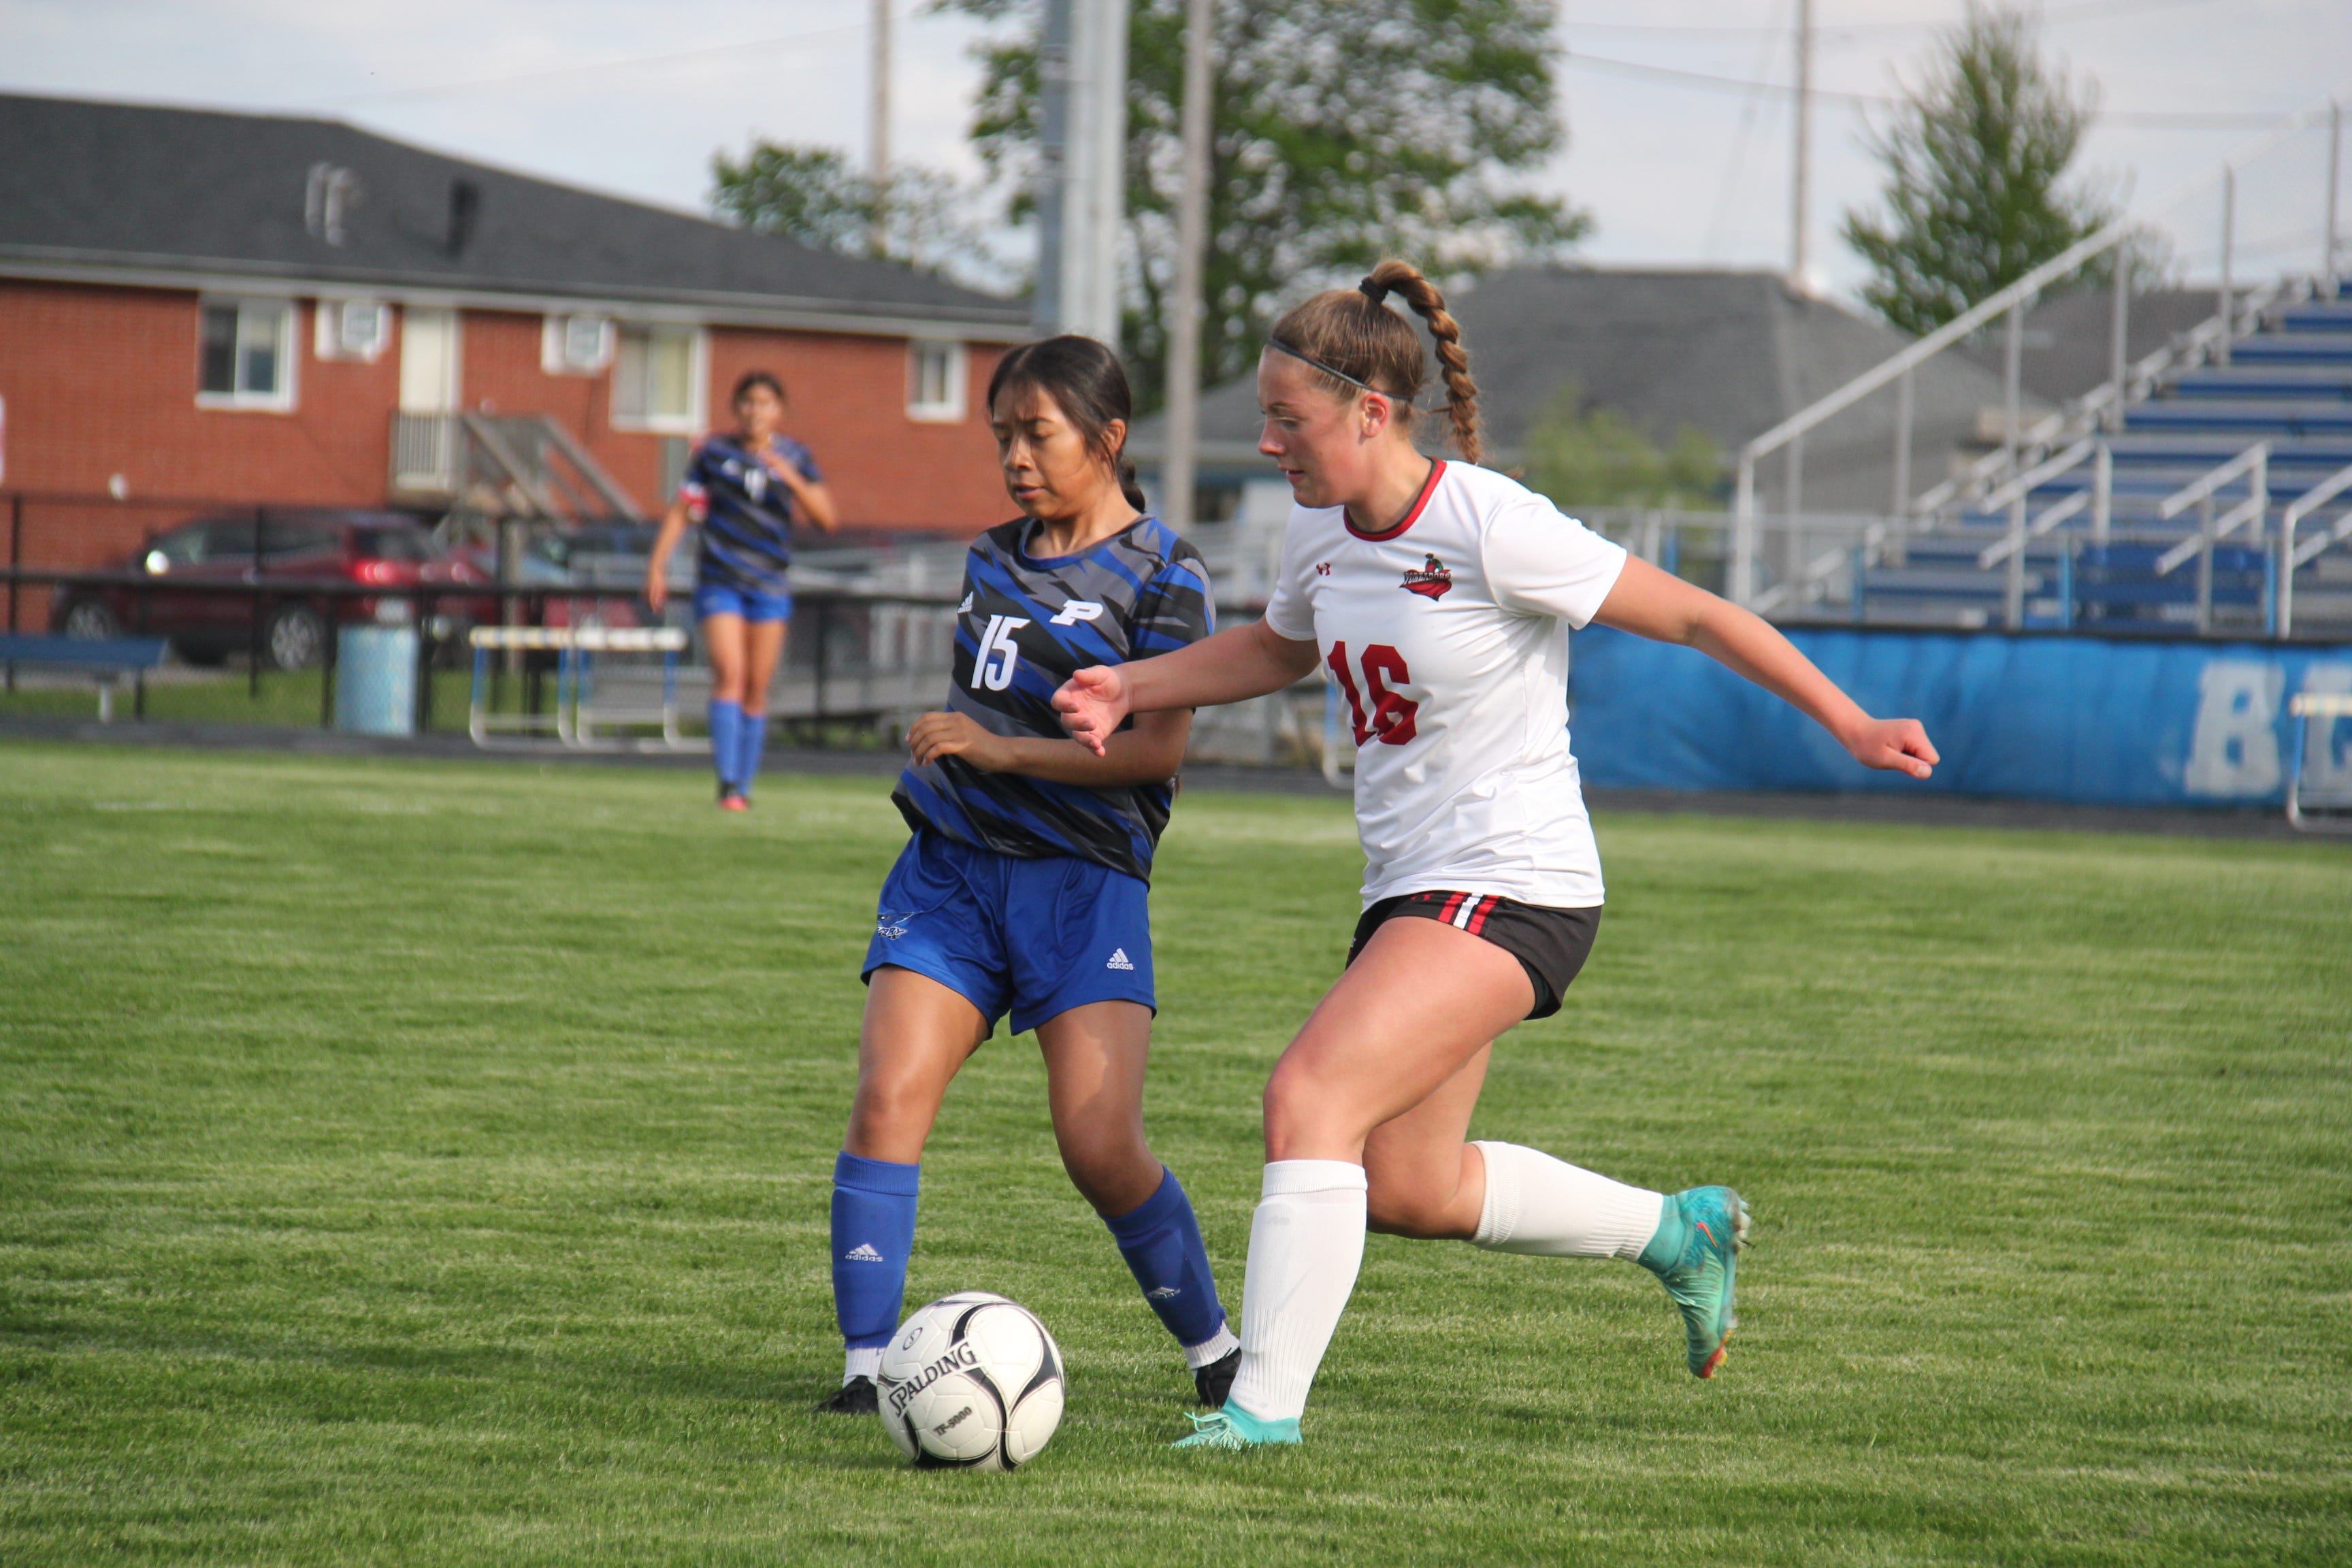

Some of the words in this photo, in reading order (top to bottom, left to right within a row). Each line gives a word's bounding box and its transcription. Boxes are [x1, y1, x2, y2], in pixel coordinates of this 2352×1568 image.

[1049, 600, 1102, 626] P
[970, 615, 1030, 691] 15
[1327, 640, 1419, 747] 16
[1107, 962, 1134, 970] adidas
[845, 1254, 883, 1262] adidas
[889, 1341, 978, 1418] SPALDING
